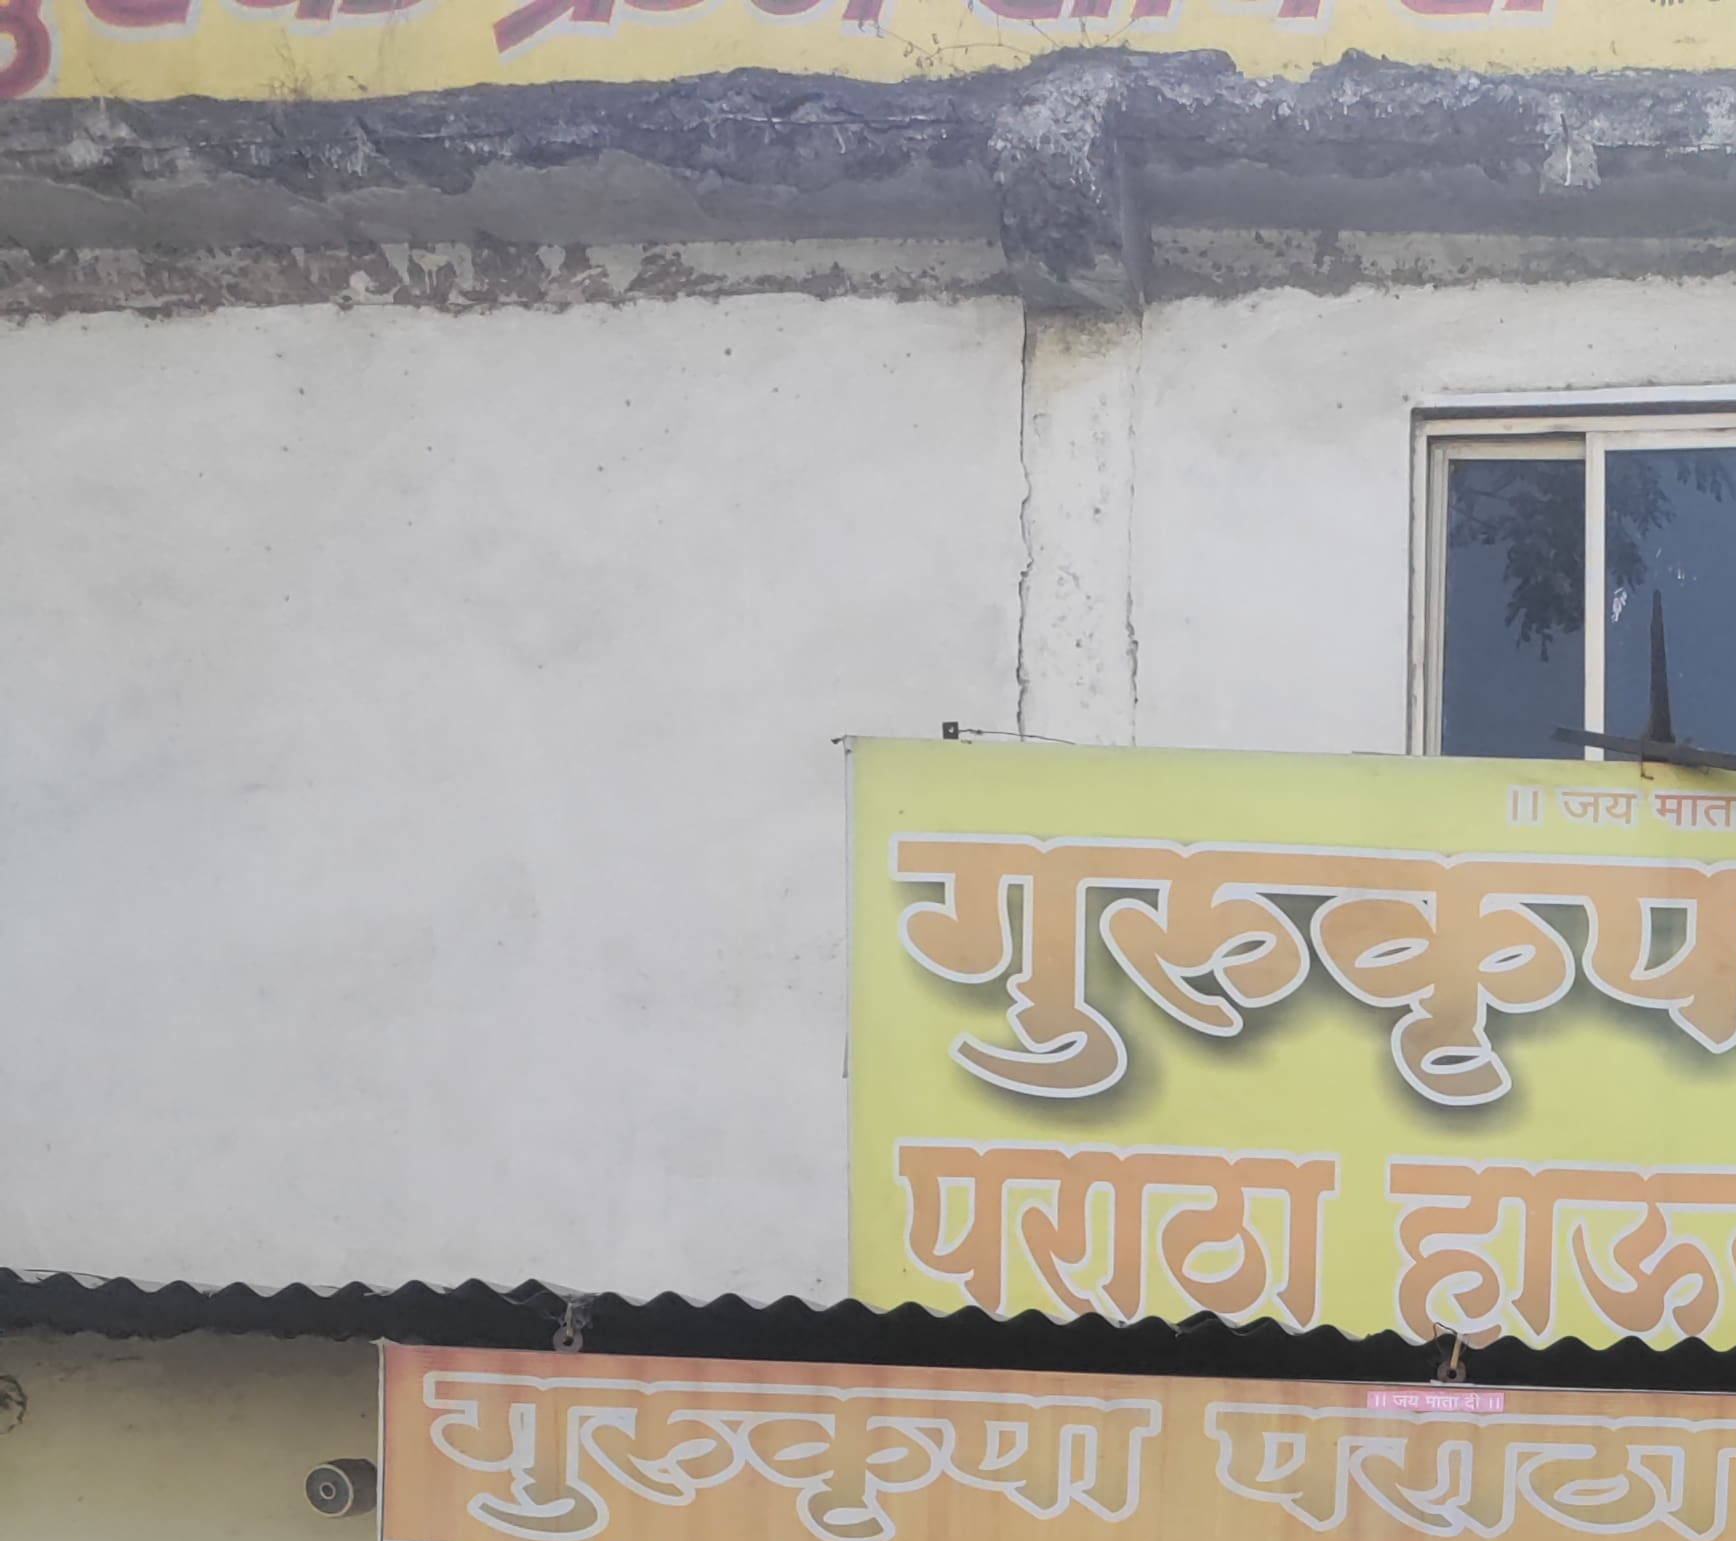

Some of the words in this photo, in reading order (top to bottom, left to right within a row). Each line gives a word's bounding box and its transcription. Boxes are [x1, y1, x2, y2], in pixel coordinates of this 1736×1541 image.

[1561, 790, 1637, 825] जय
[895, 1139, 1339, 1328] पराठा
[1393, 1394, 1419, 1409] जय
[1425, 1395, 1459, 1409] माता
[1463, 1392, 1481, 1410] दी
